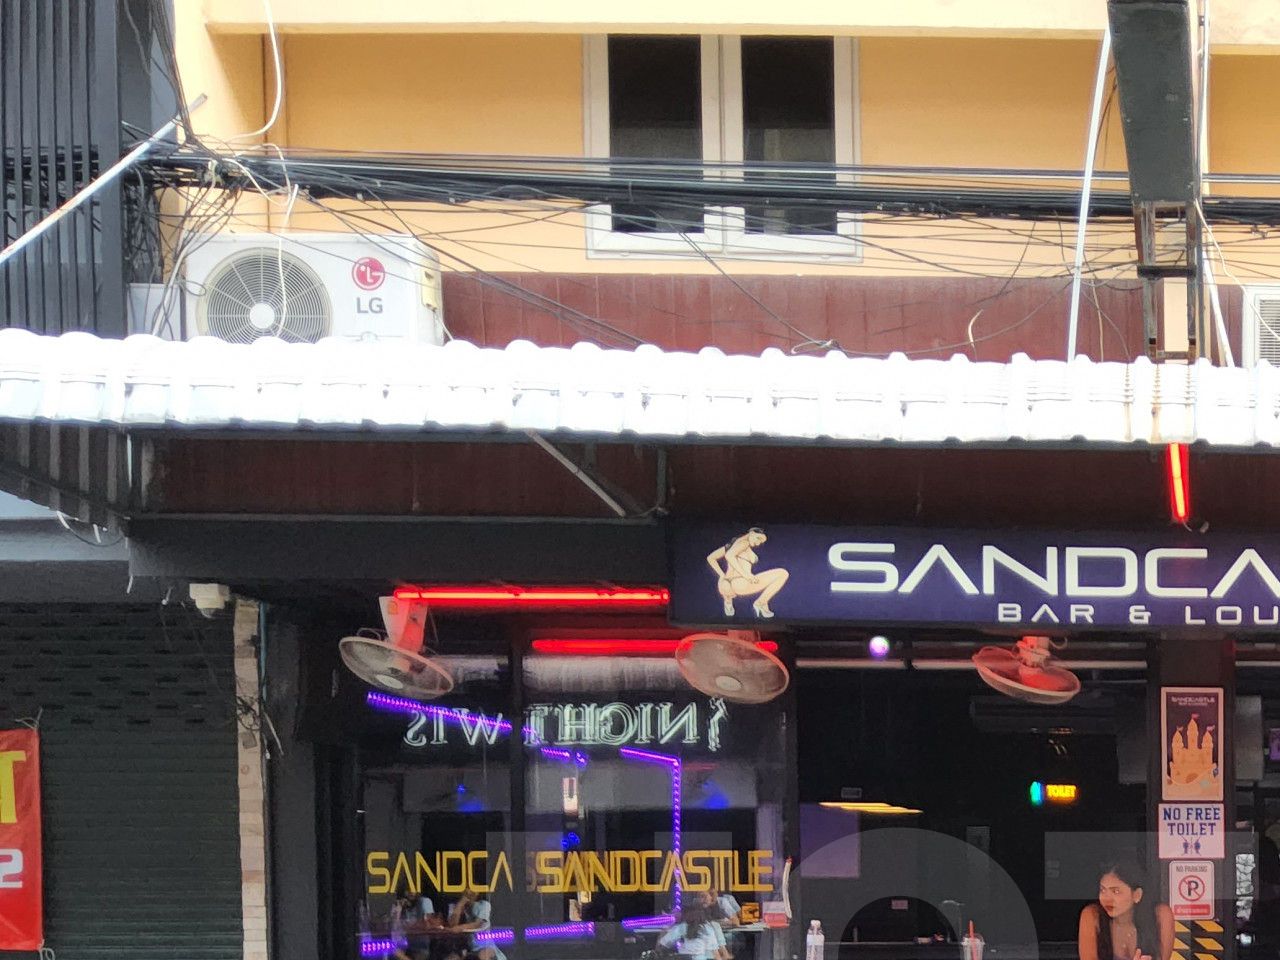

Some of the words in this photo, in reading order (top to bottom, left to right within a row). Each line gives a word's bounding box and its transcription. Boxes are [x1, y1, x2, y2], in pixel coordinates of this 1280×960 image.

[356, 297, 383, 314] LG
[998, 603, 1095, 623] BAR
[1129, 606, 1151, 624] &
[1163, 807, 1182, 821] NO
[1186, 807, 1221, 821] FREE
[1168, 822, 1217, 836] TOILET
[537, 850, 774, 893] SANDCASTLE
